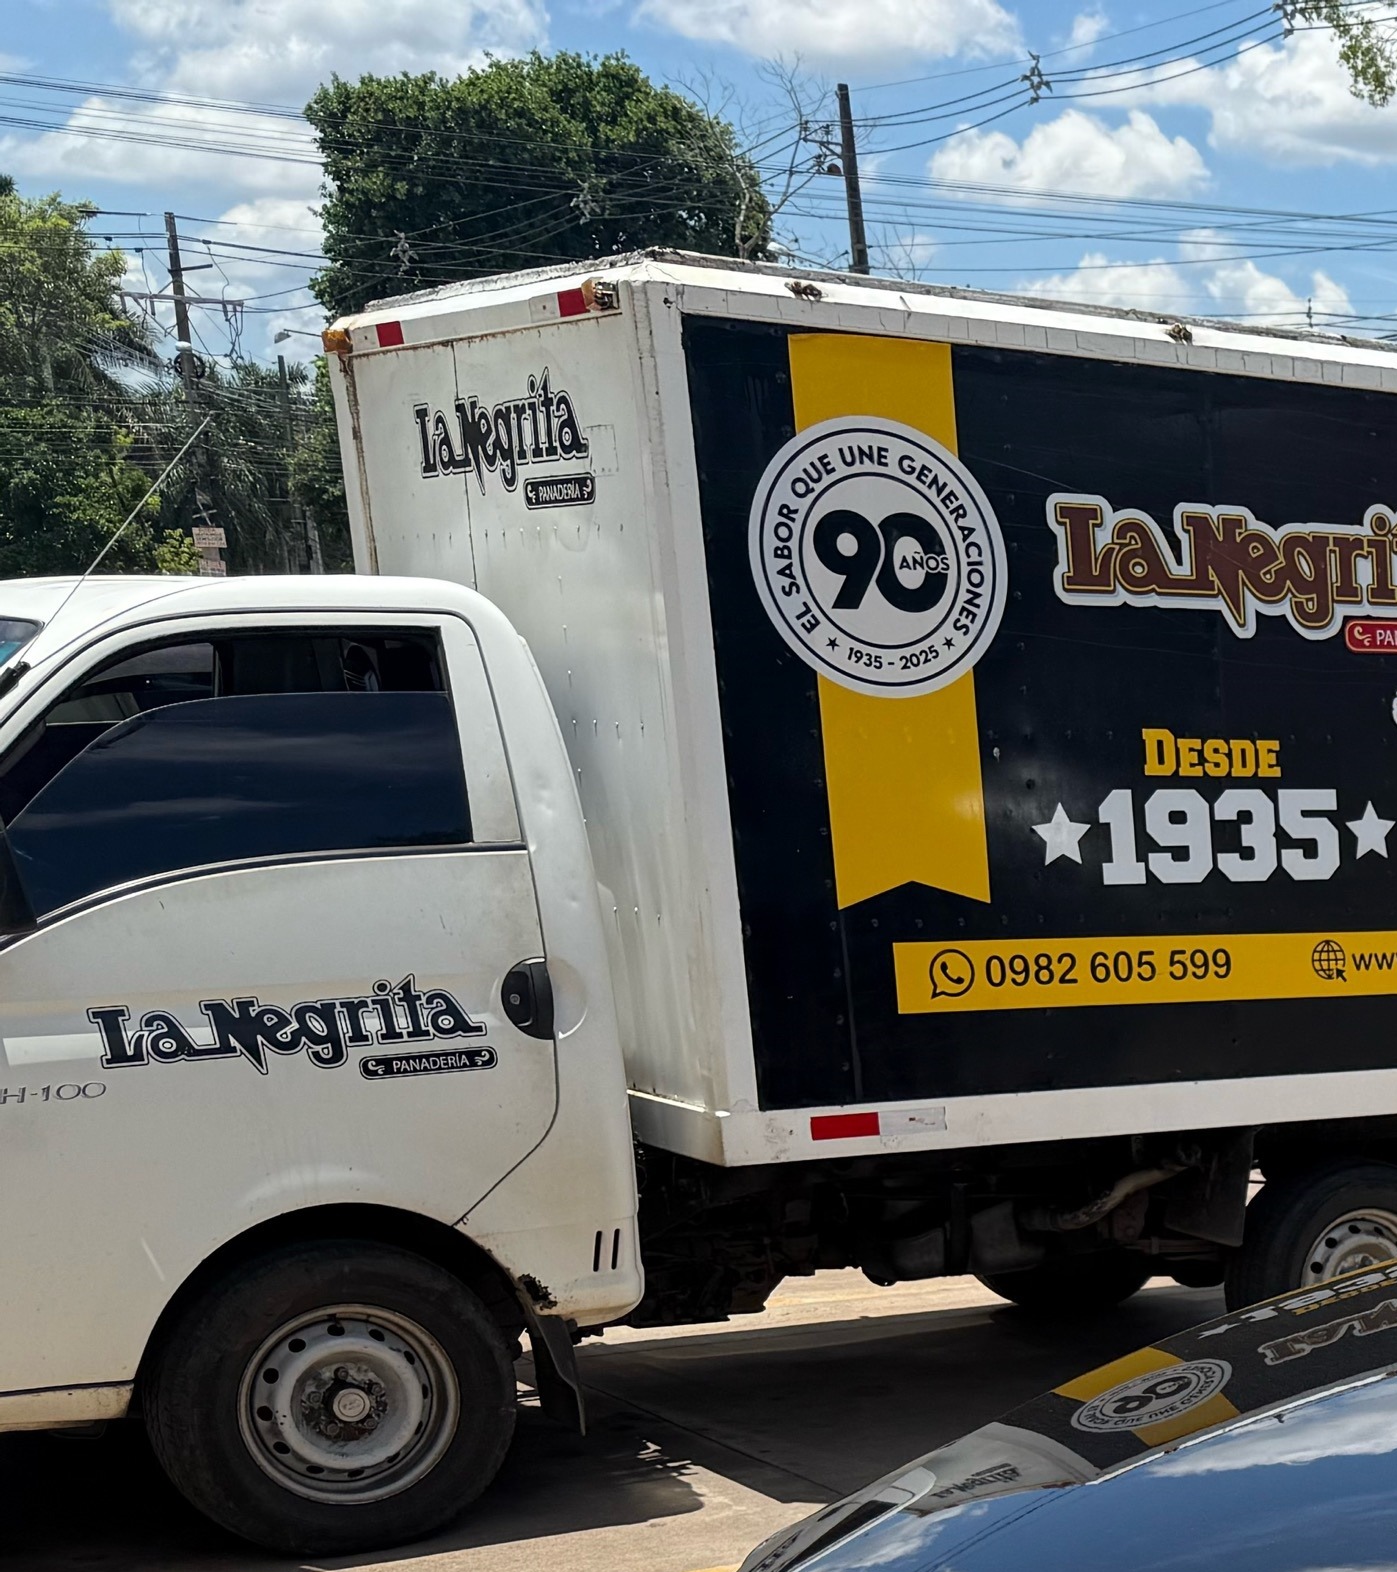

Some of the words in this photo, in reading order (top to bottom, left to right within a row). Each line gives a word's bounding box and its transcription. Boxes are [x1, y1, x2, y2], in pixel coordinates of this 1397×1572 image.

[455, 366, 589, 496] Negrita
[838, 444, 889, 468] UNE
[538, 480, 581, 501] PANADERÍA
[790, 453, 836, 499] QUE
[773, 503, 800, 597] SABOR
[813, 509, 949, 613] 90
[898, 454, 985, 637] GENERACIONES
[898, 552, 950, 572] AÑOS
[795, 601, 821, 634] EL
[846, 646, 883, 669] 1935
[900, 645, 940, 670] 2025
[1099, 789, 1341, 885] 1935
[985, 953, 1078, 987] 0982
[1090, 951, 1156, 983] 605
[1169, 948, 1232, 980] 599
[199, 974, 487, 1075] Negrita
[392, 1054, 470, 1073] PANADERÍA
[0, 1082, 106, 1104] H-100
